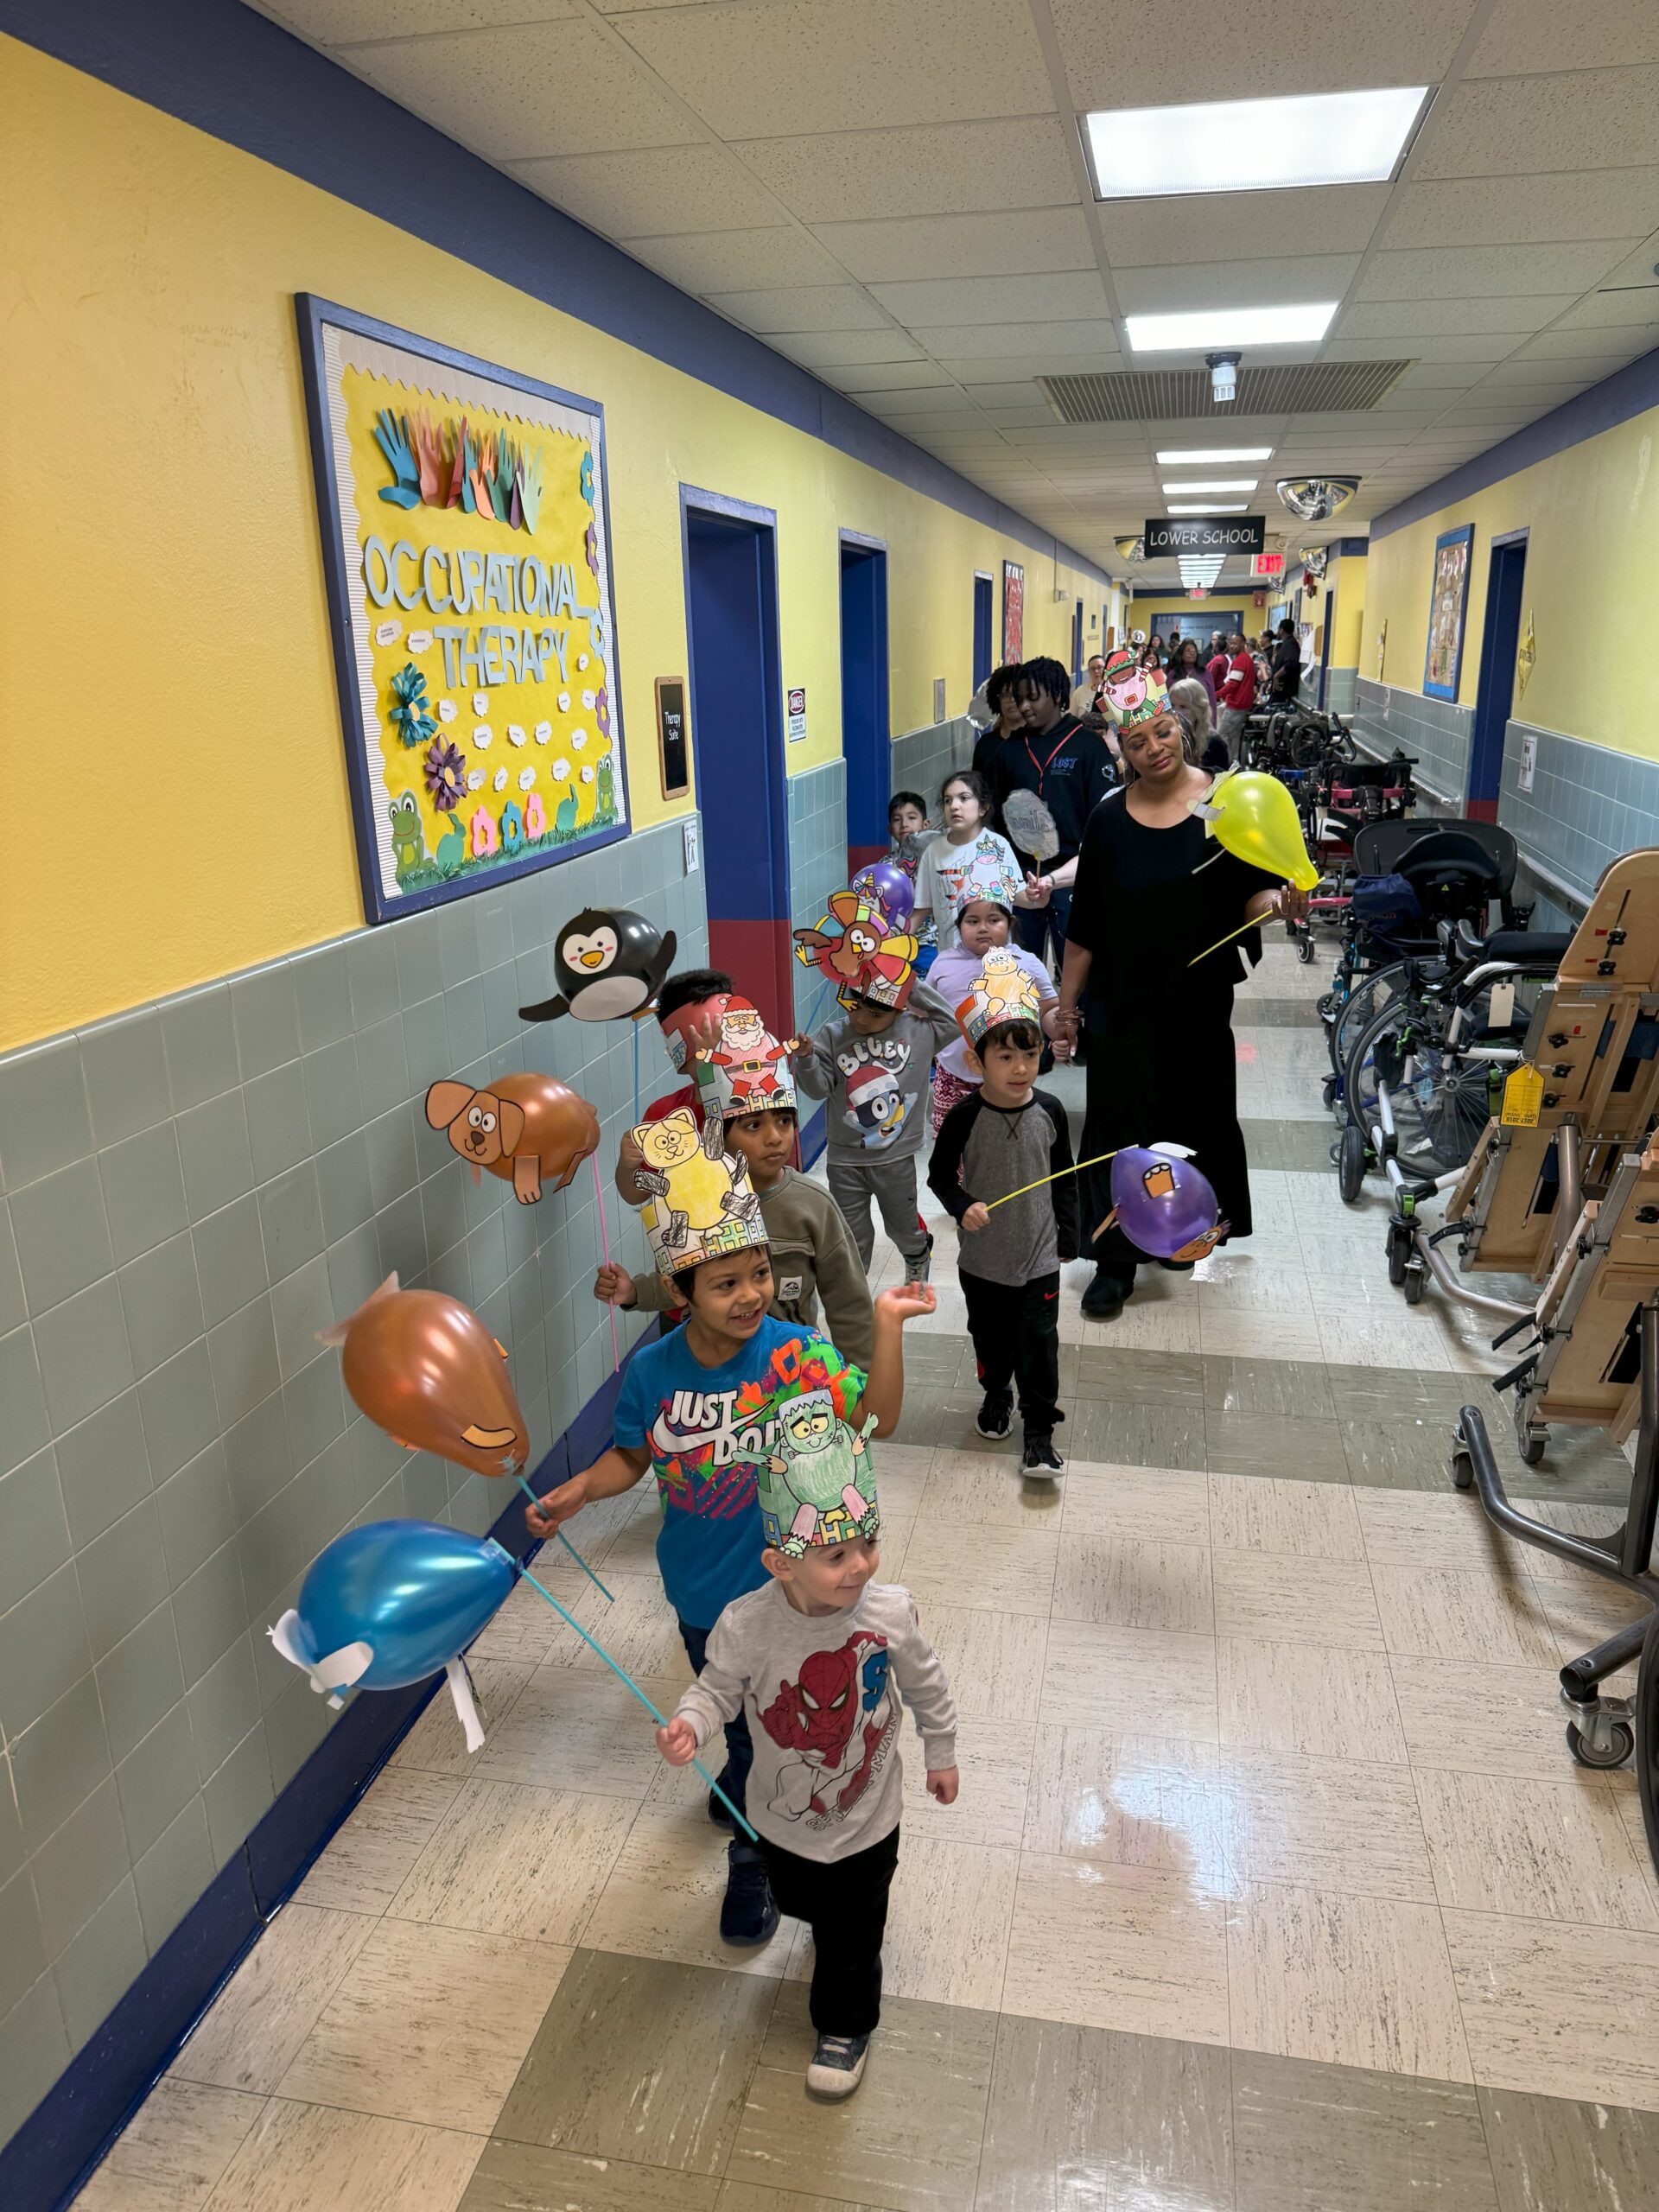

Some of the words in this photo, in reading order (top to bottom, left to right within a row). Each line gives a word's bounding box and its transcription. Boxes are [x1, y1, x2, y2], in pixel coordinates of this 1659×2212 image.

[1150, 531, 1198, 546] LOWER
[1202, 529, 1258, 544] SCHOOL
[365, 535, 595, 620] OCCUPATIONAL
[1257, 554, 1283, 574] EXIT
[434, 626, 569, 689] THERAPY
[664, 712, 681, 728] Therapy
[669, 729, 679, 741] Suite
[836, 1037, 911, 1077] BLUEY
[667, 1389, 738, 1428] JUST
[712, 1427, 762, 1466] DO
